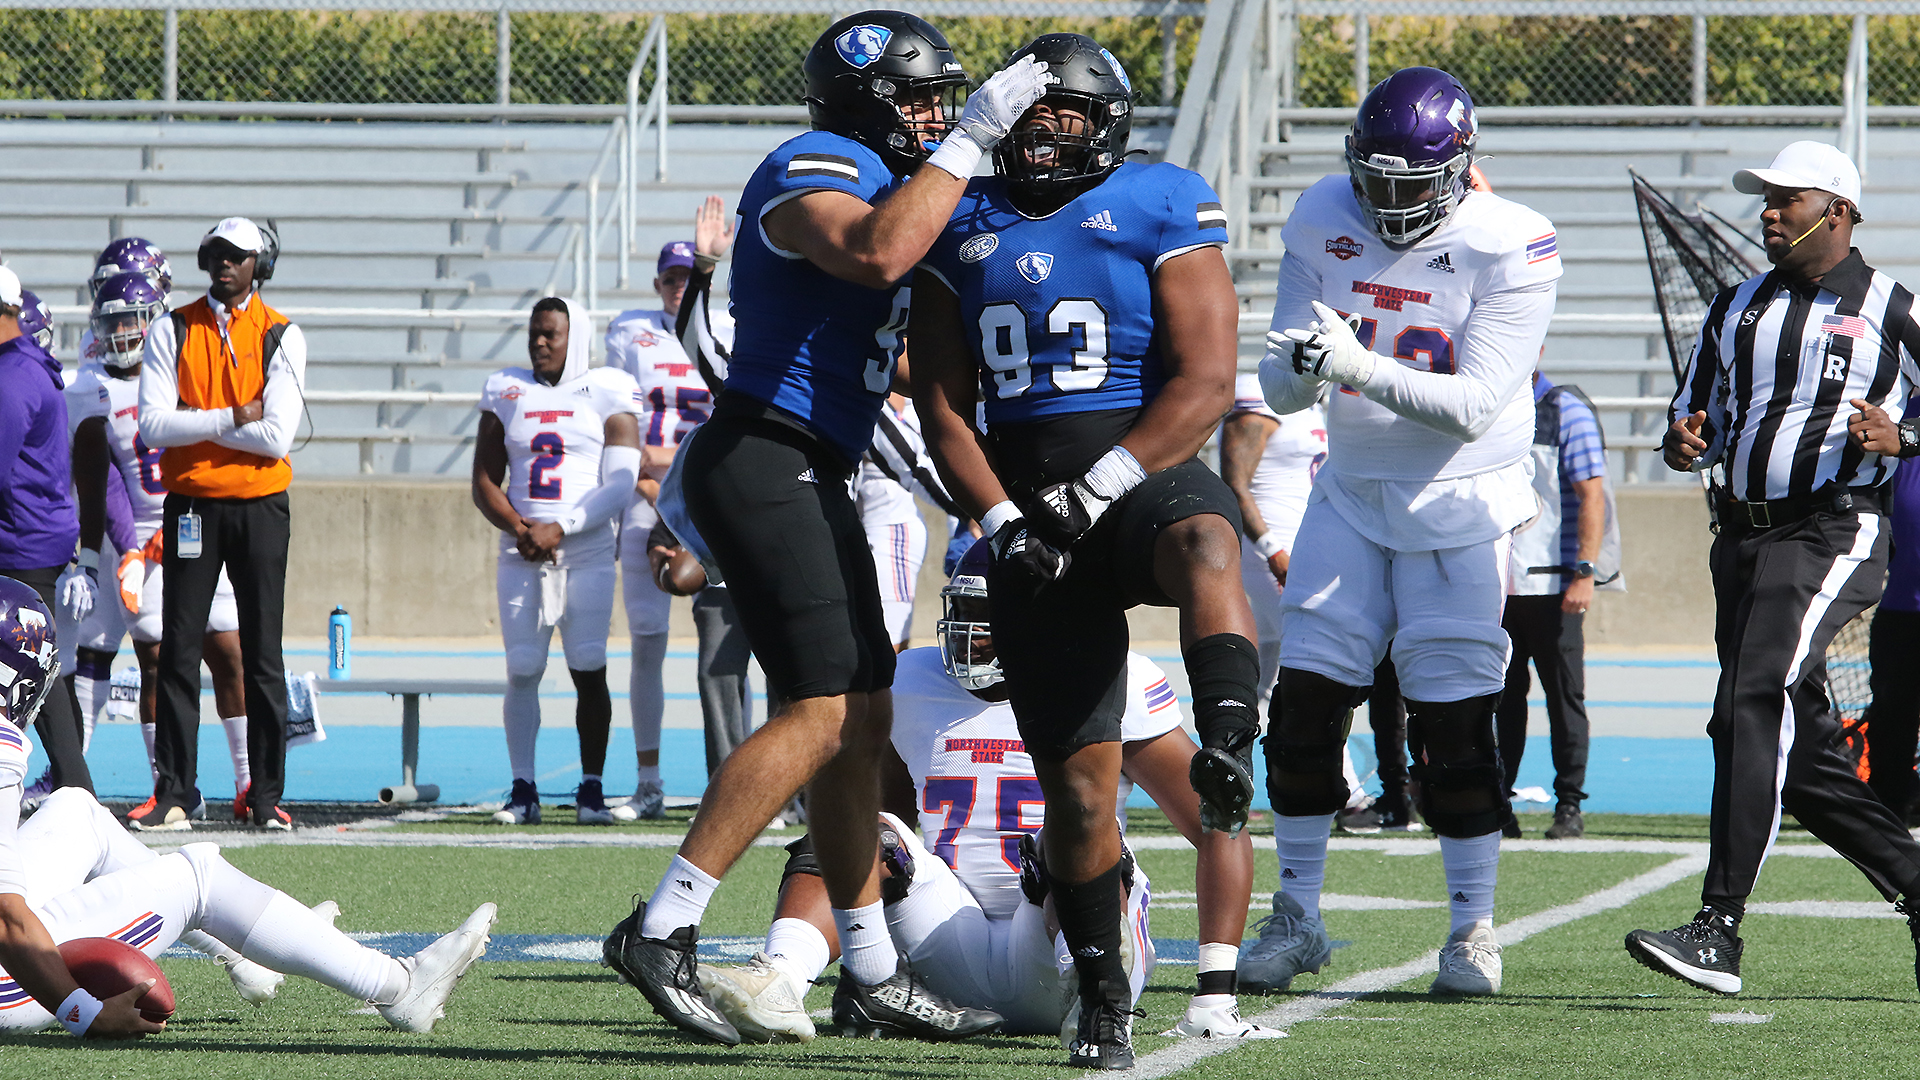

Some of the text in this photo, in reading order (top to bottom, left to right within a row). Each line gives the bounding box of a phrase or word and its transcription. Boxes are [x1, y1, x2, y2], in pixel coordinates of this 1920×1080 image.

[1080, 220, 1118, 232] adidas
[1426, 261, 1455, 274] adidas
[1352, 281, 1432, 304] NORTHWESTERN
[1373, 296, 1403, 312] STATE
[1741, 309, 1759, 326] S
[977, 297, 1110, 400] 93
[1823, 353, 1846, 382] R
[645, 386, 711, 446] 15
[529, 431, 565, 500] 2
[1057, 484, 1070, 518] adidas
[945, 739, 1026, 752] NORTHWESTER
[971, 751, 1004, 763] STATE
[922, 776, 1046, 873] 75
